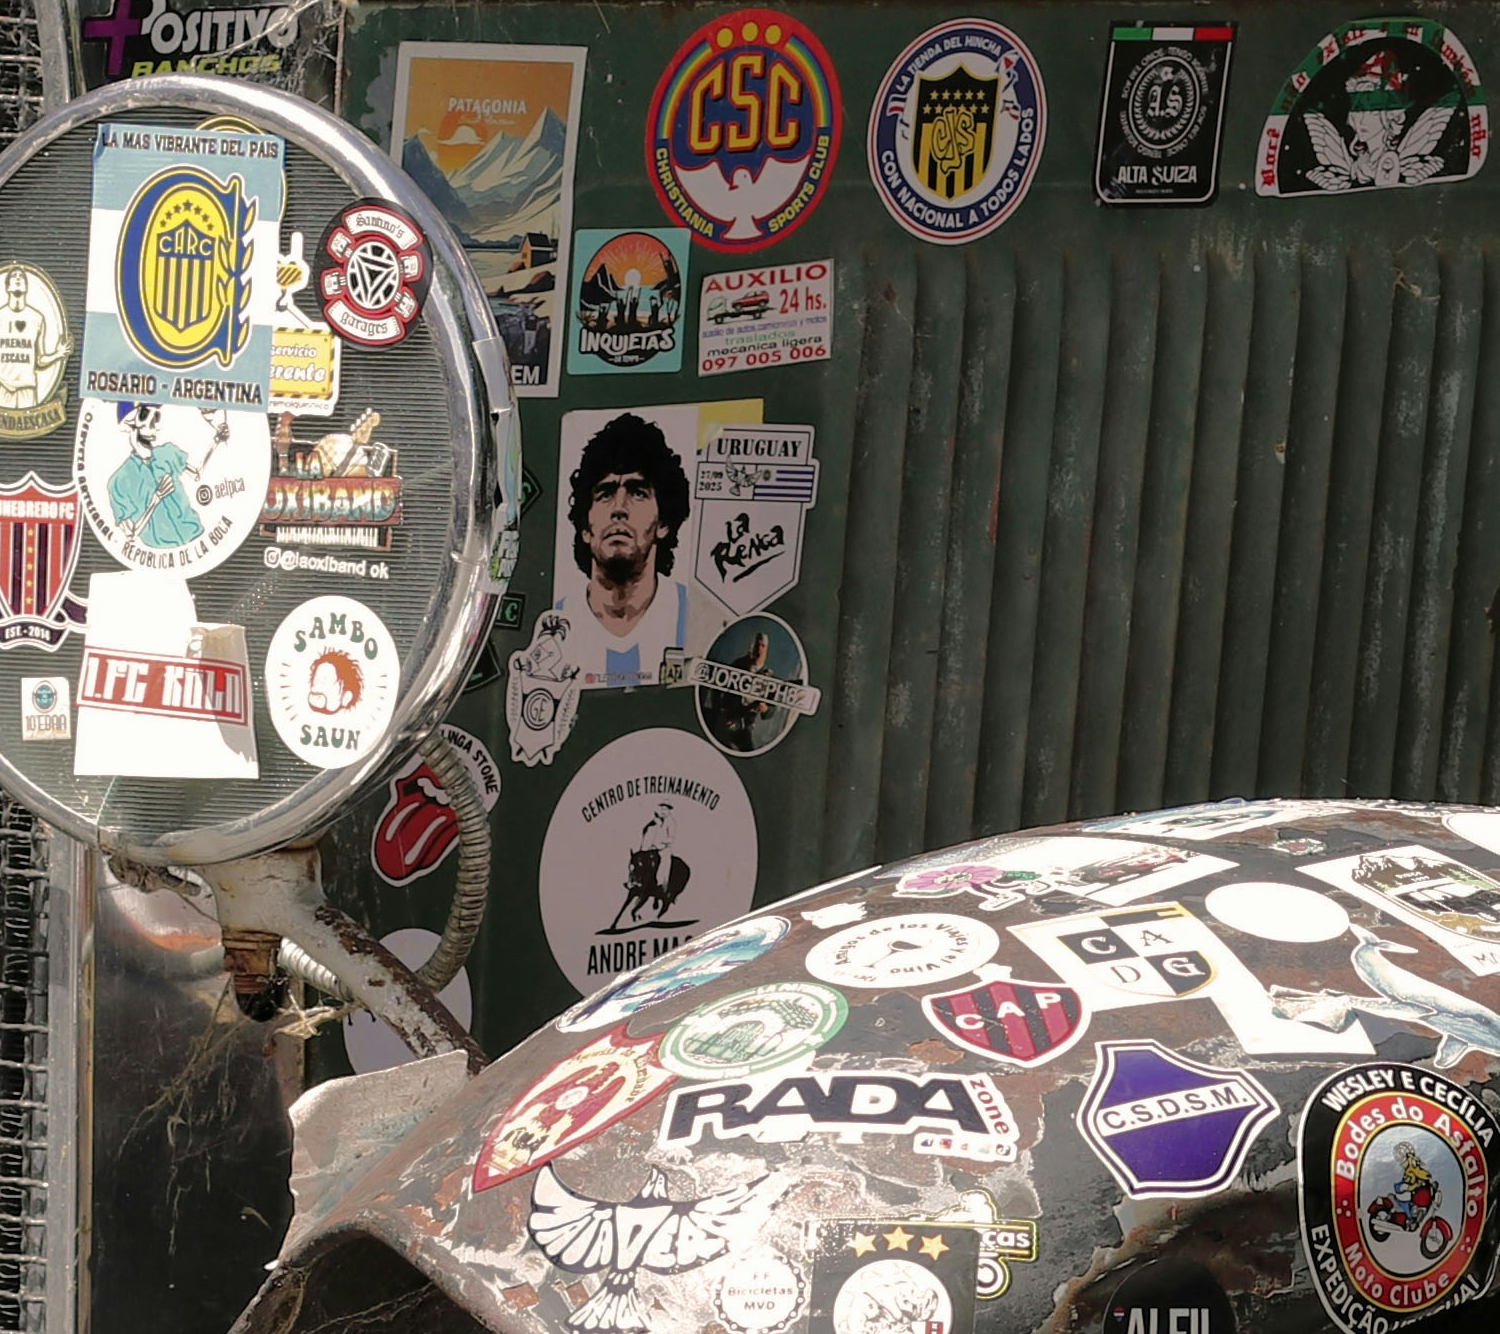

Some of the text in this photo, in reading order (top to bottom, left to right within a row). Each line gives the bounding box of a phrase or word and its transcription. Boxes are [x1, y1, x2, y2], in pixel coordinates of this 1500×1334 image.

[897, 35, 1002, 95] LA TIENDA DEL HINCHA
[448, 96, 528, 115] PATAGONIA
[102, 134, 278, 158] LA MAS VIBRANTE DEL PAIS
[1118, 165, 1197, 184] ALTA SUIZA
[705, 264, 828, 294] AUXILIO
[779, 287, 828, 314] 24 hs.
[702, 344, 827, 371] 097 005 006
[87, 371, 263, 403] ROSARIO ARGENTINA
[716, 437, 802, 459] URUGUAY
[57, 501, 75, 521] FC
[294, 613, 380, 661] SAMBO
[299, 727, 361, 750] SAUN
[466, 749, 499, 795] STONE
[581, 776, 721, 823] CENTRO DE TREINAMENTO
[955, 992, 1062, 1030] CAP
[666, 1076, 984, 1143] RADA
[1101, 1081, 1249, 1132] C.S.D.S.M.
[1322, 1069, 1495, 1148] WESLEY E CECÍLIA
[1336, 1097, 1486, 1217] Bodes do Asfalto
[1345, 1241, 1450, 1305] Moto Clube
[726, 1285, 796, 1298] Bicicletas
[743, 1299, 776, 1313] MVD
